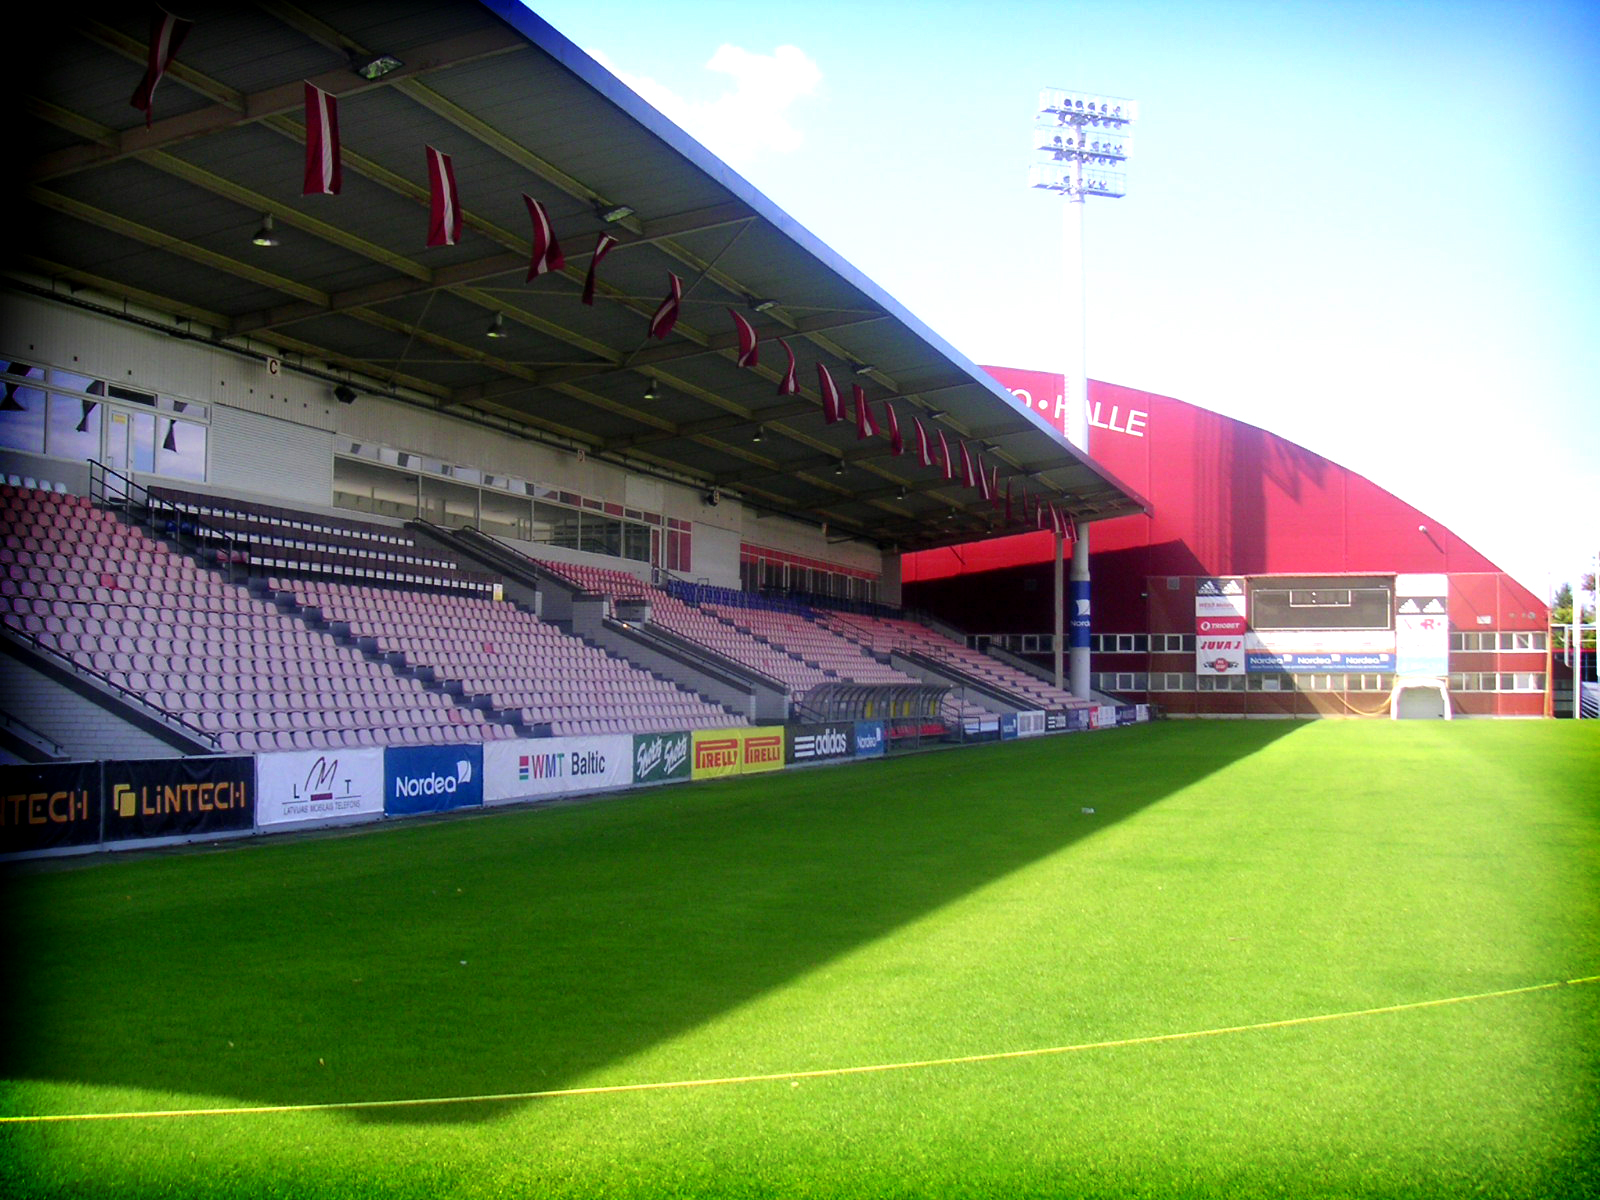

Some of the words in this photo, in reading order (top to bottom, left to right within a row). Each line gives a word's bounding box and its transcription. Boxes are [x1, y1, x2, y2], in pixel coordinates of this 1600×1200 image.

[269, 359, 278, 375] C
[1054, 394, 1148, 437] HLLE
[1201, 641, 1231, 650] JUVA
[1250, 656, 1284, 664] Nordea
[1297, 656, 1331, 665] Nordea
[1345, 656, 1380, 665] Nordea
[696, 739, 738, 769] PIRELLI
[744, 736, 780, 764] PIRELLI
[815, 728, 847, 755] adidas
[857, 735, 876, 748] Nordea
[532, 753, 565, 780] WMT
[571, 751, 605, 776] Baltic
[396, 772, 456, 798] Nordea
